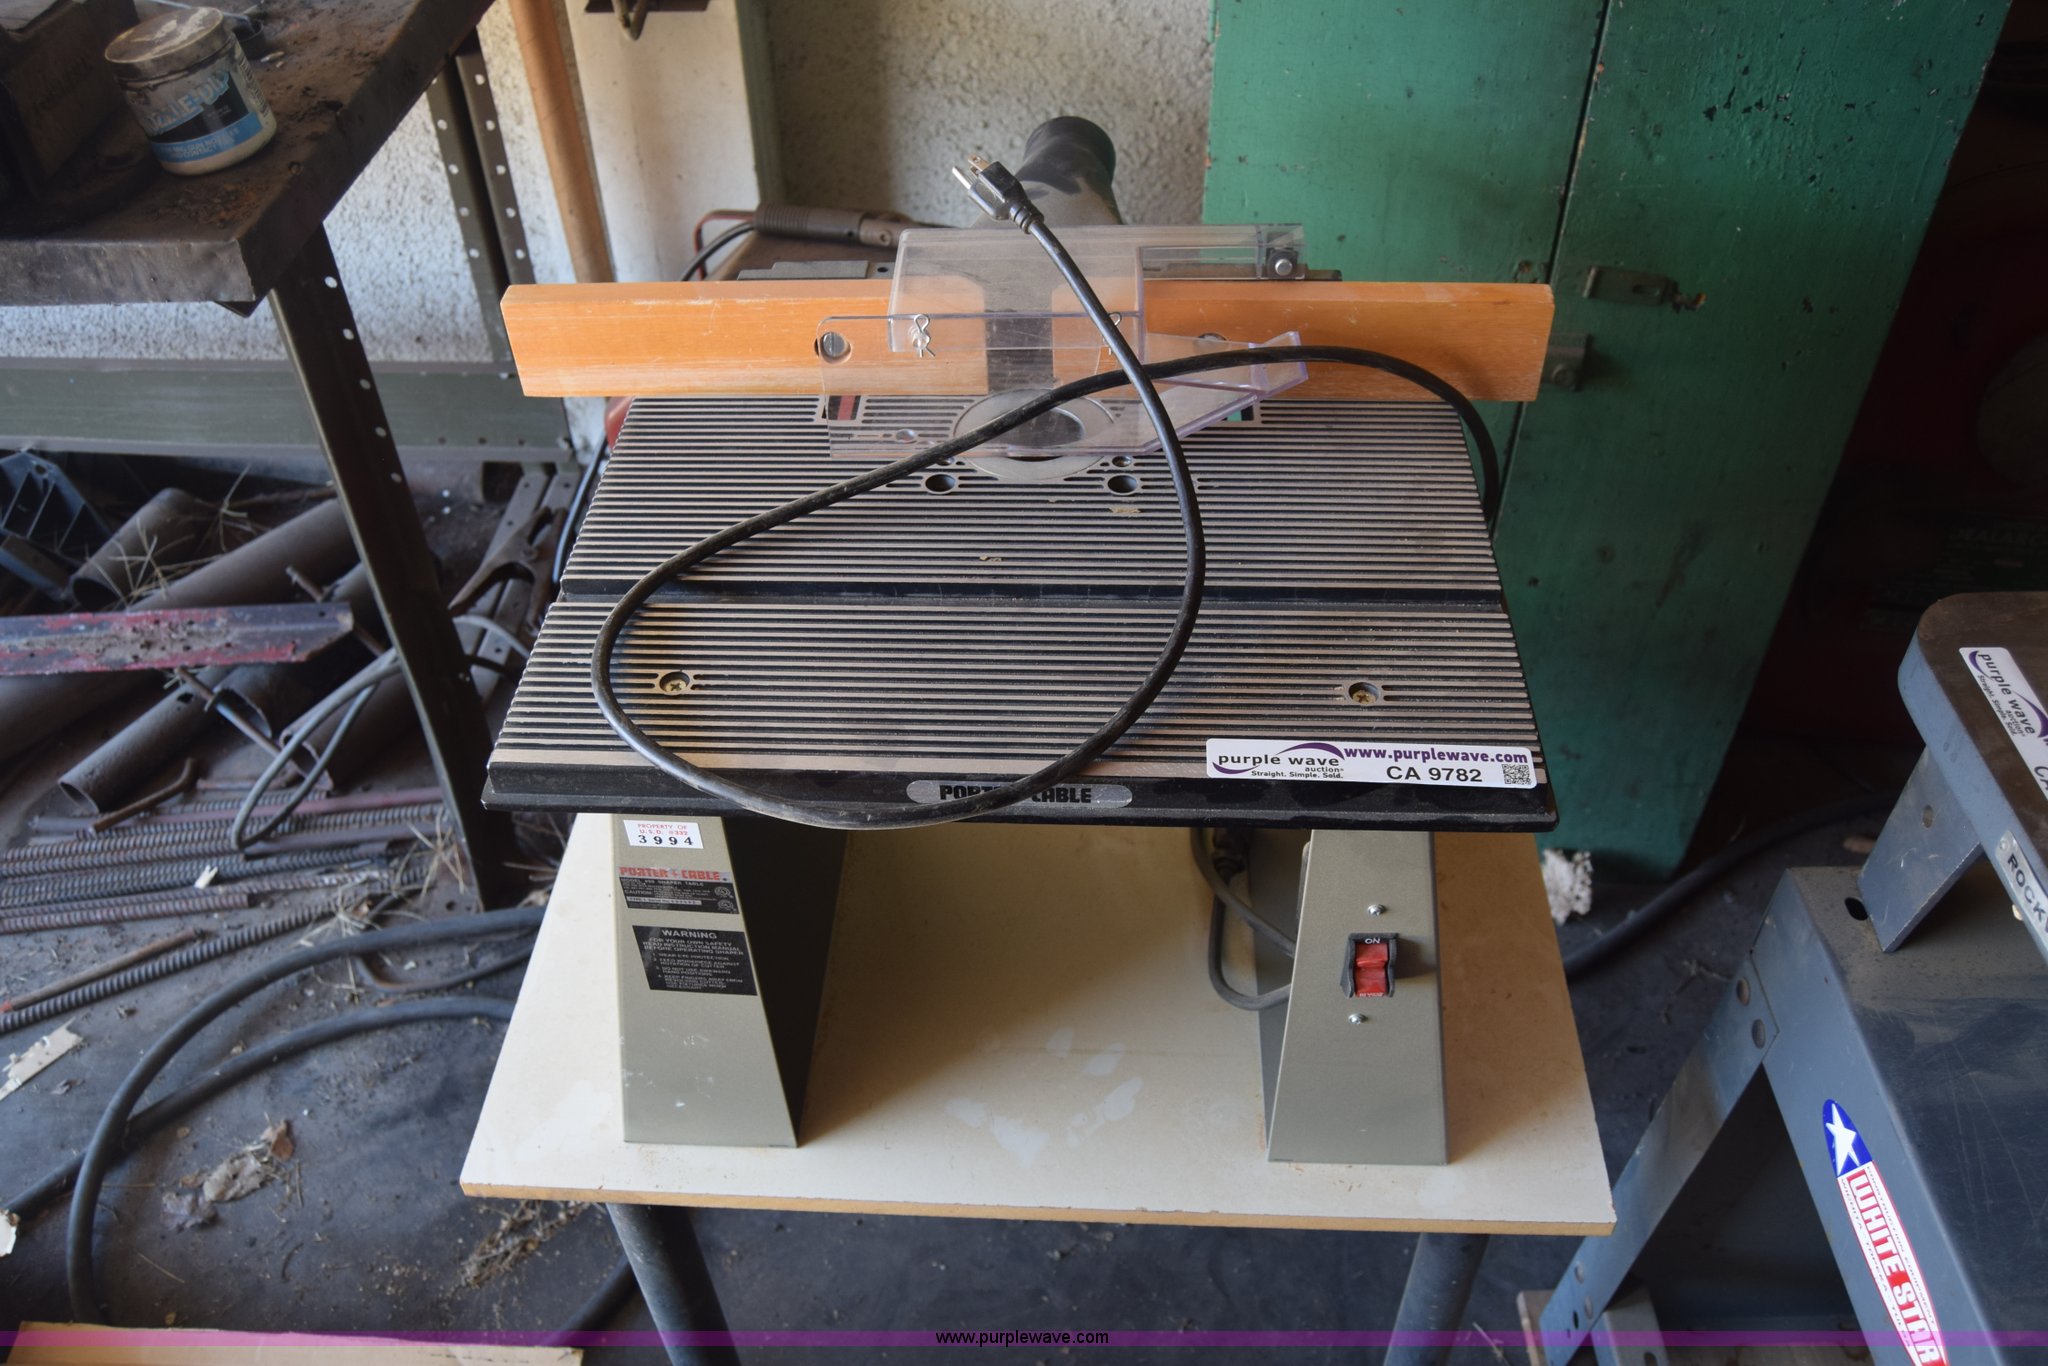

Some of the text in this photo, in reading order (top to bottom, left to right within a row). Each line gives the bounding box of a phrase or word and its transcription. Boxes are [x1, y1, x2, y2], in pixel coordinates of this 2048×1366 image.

[1978, 654, 2035, 734] purple wave
[1218, 754, 1339, 766] purple wave
[1344, 748, 1528, 763] www.purplewave.com
[1251, 770, 1287, 778] Straight.
[1289, 771, 1320, 779] Simple.
[1386, 766, 1483, 782] CA 9782
[2008, 853, 2048, 933] ROCK
[661, 929, 718, 939] WARNING
[1849, 1173, 1941, 1364] WHITE STAR
